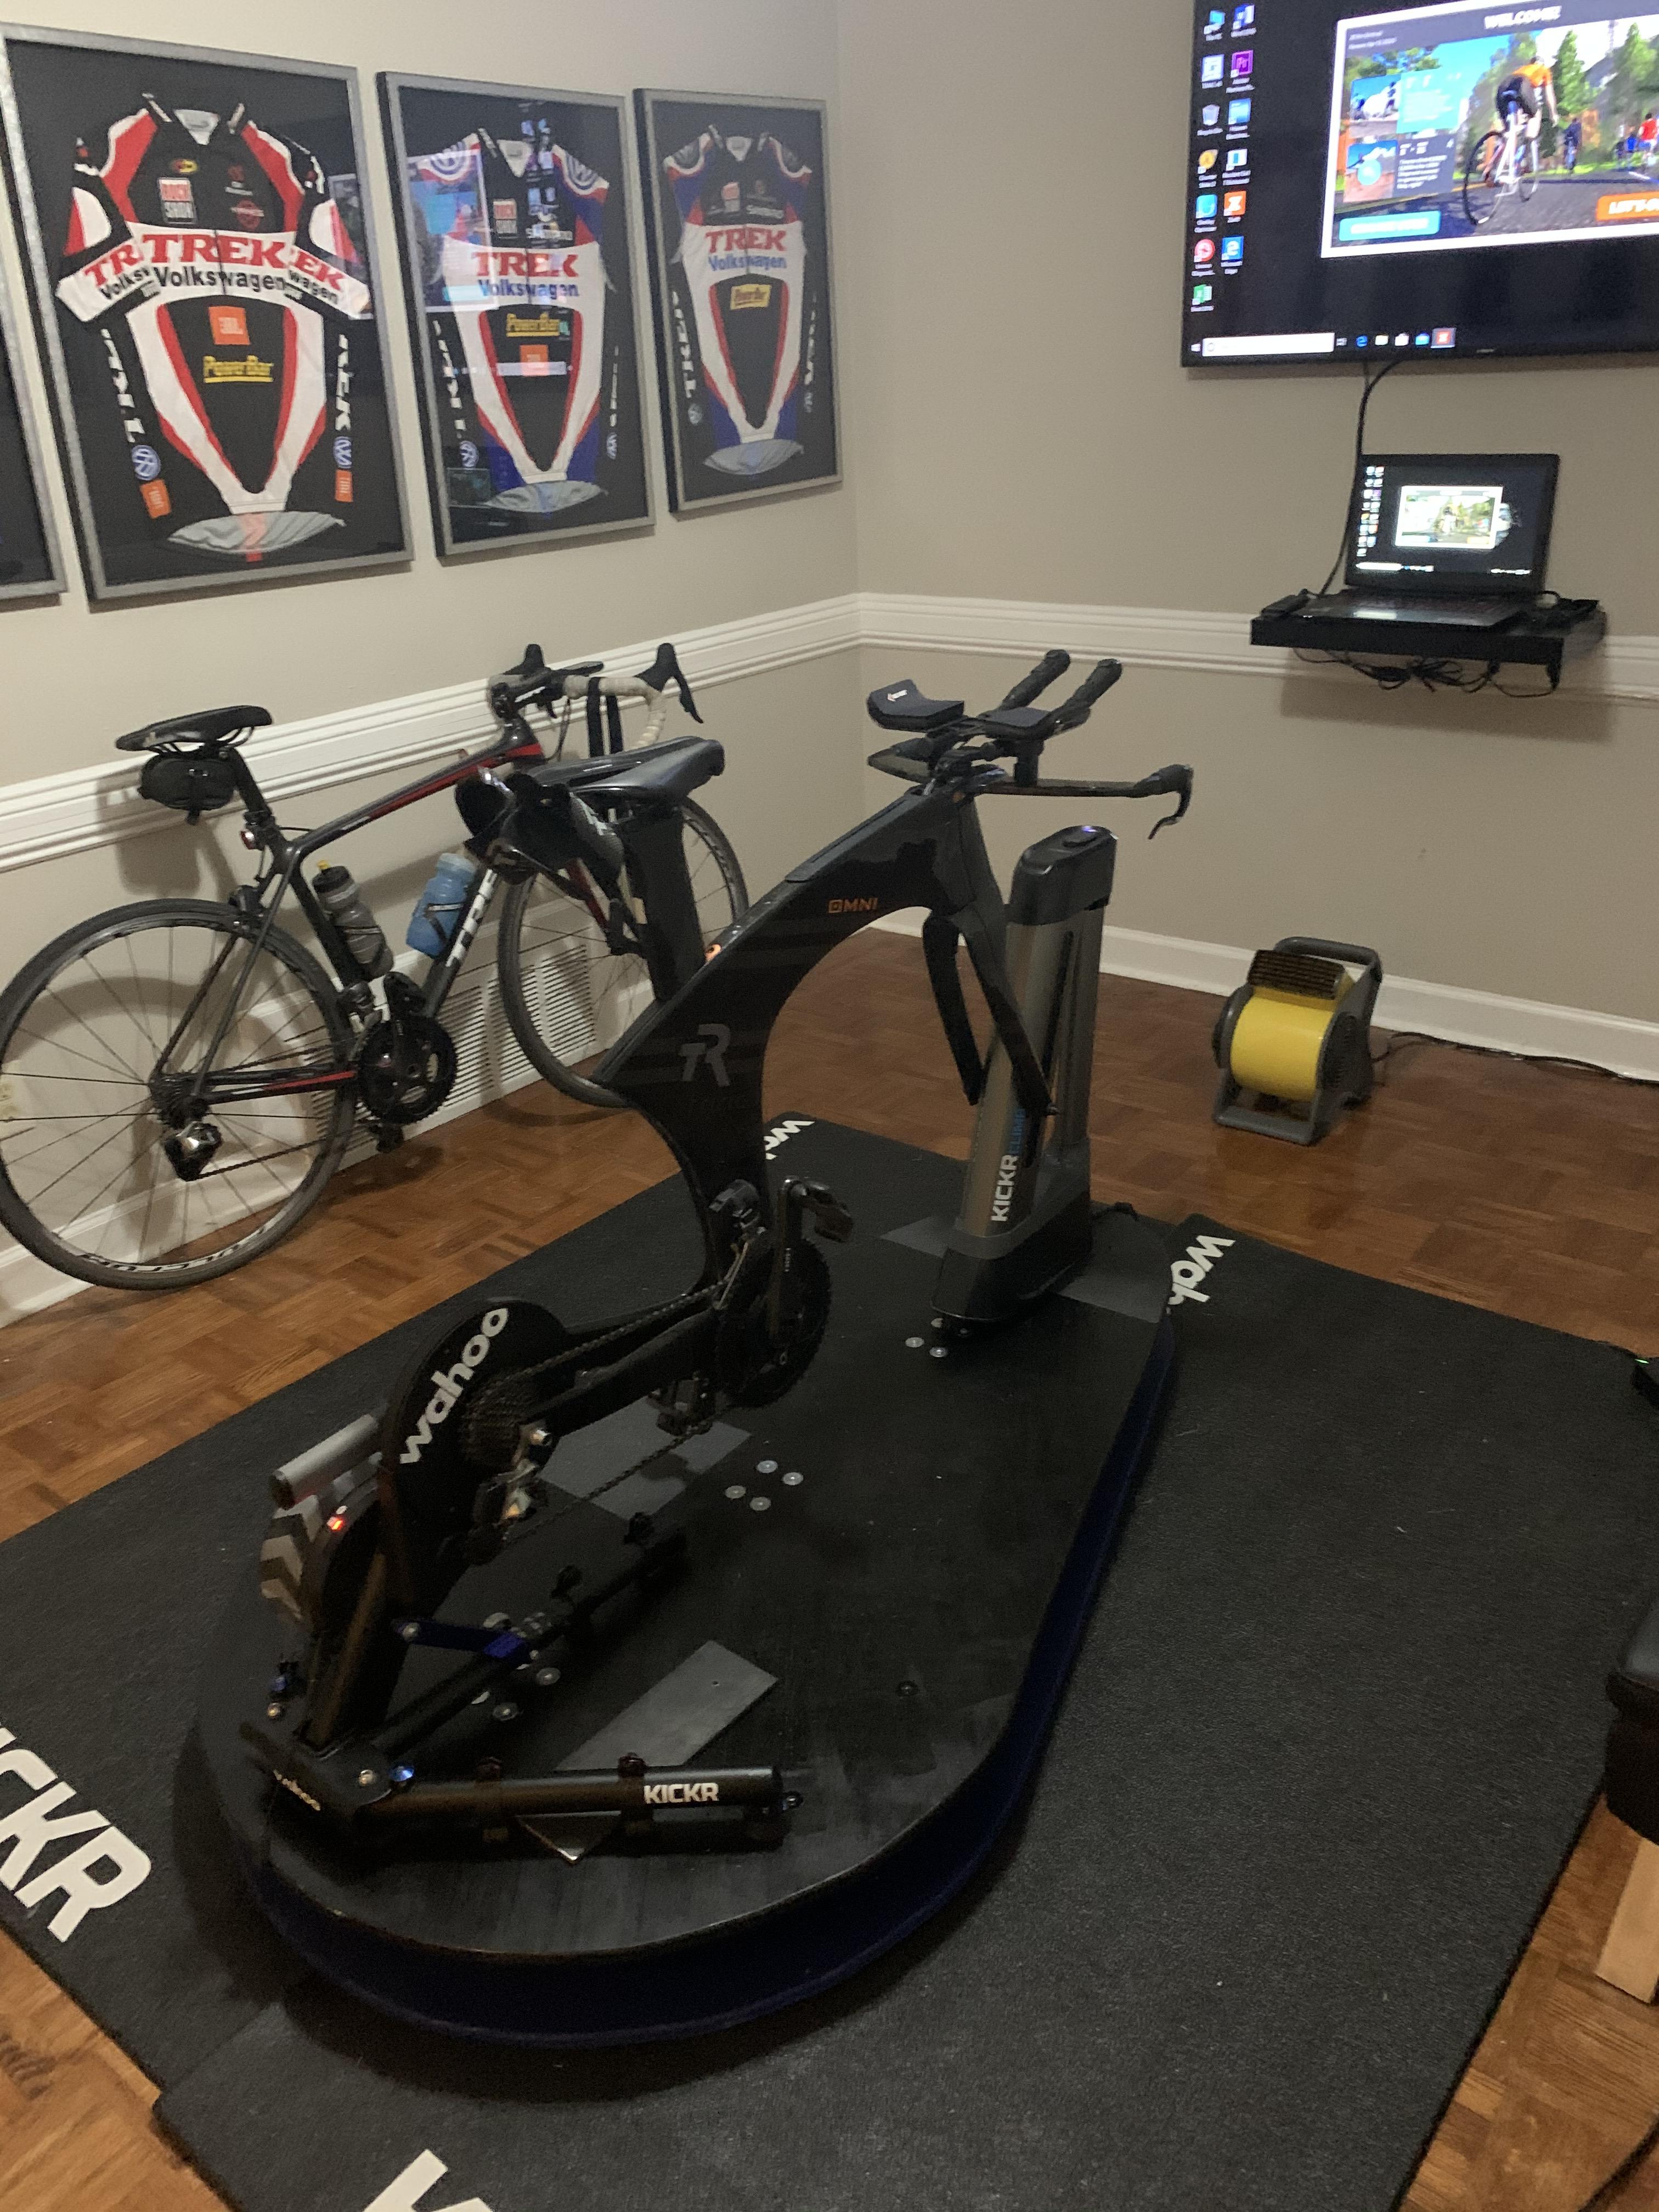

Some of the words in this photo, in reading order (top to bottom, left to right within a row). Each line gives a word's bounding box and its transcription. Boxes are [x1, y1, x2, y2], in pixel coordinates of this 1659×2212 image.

[143, 234, 285, 269] TREK
[705, 226, 787, 253] TREK
[84, 244, 144, 286] TR
[154, 266, 286, 293] Volkswagen
[290, 247, 345, 292] EK
[472, 251, 579, 277] TREK
[478, 279, 579, 300] Volkswagen
[991, 1154, 1019, 1222] KICKR
[399, 1307, 509, 1464] wahoo
[644, 1782, 719, 1804] KICKR
